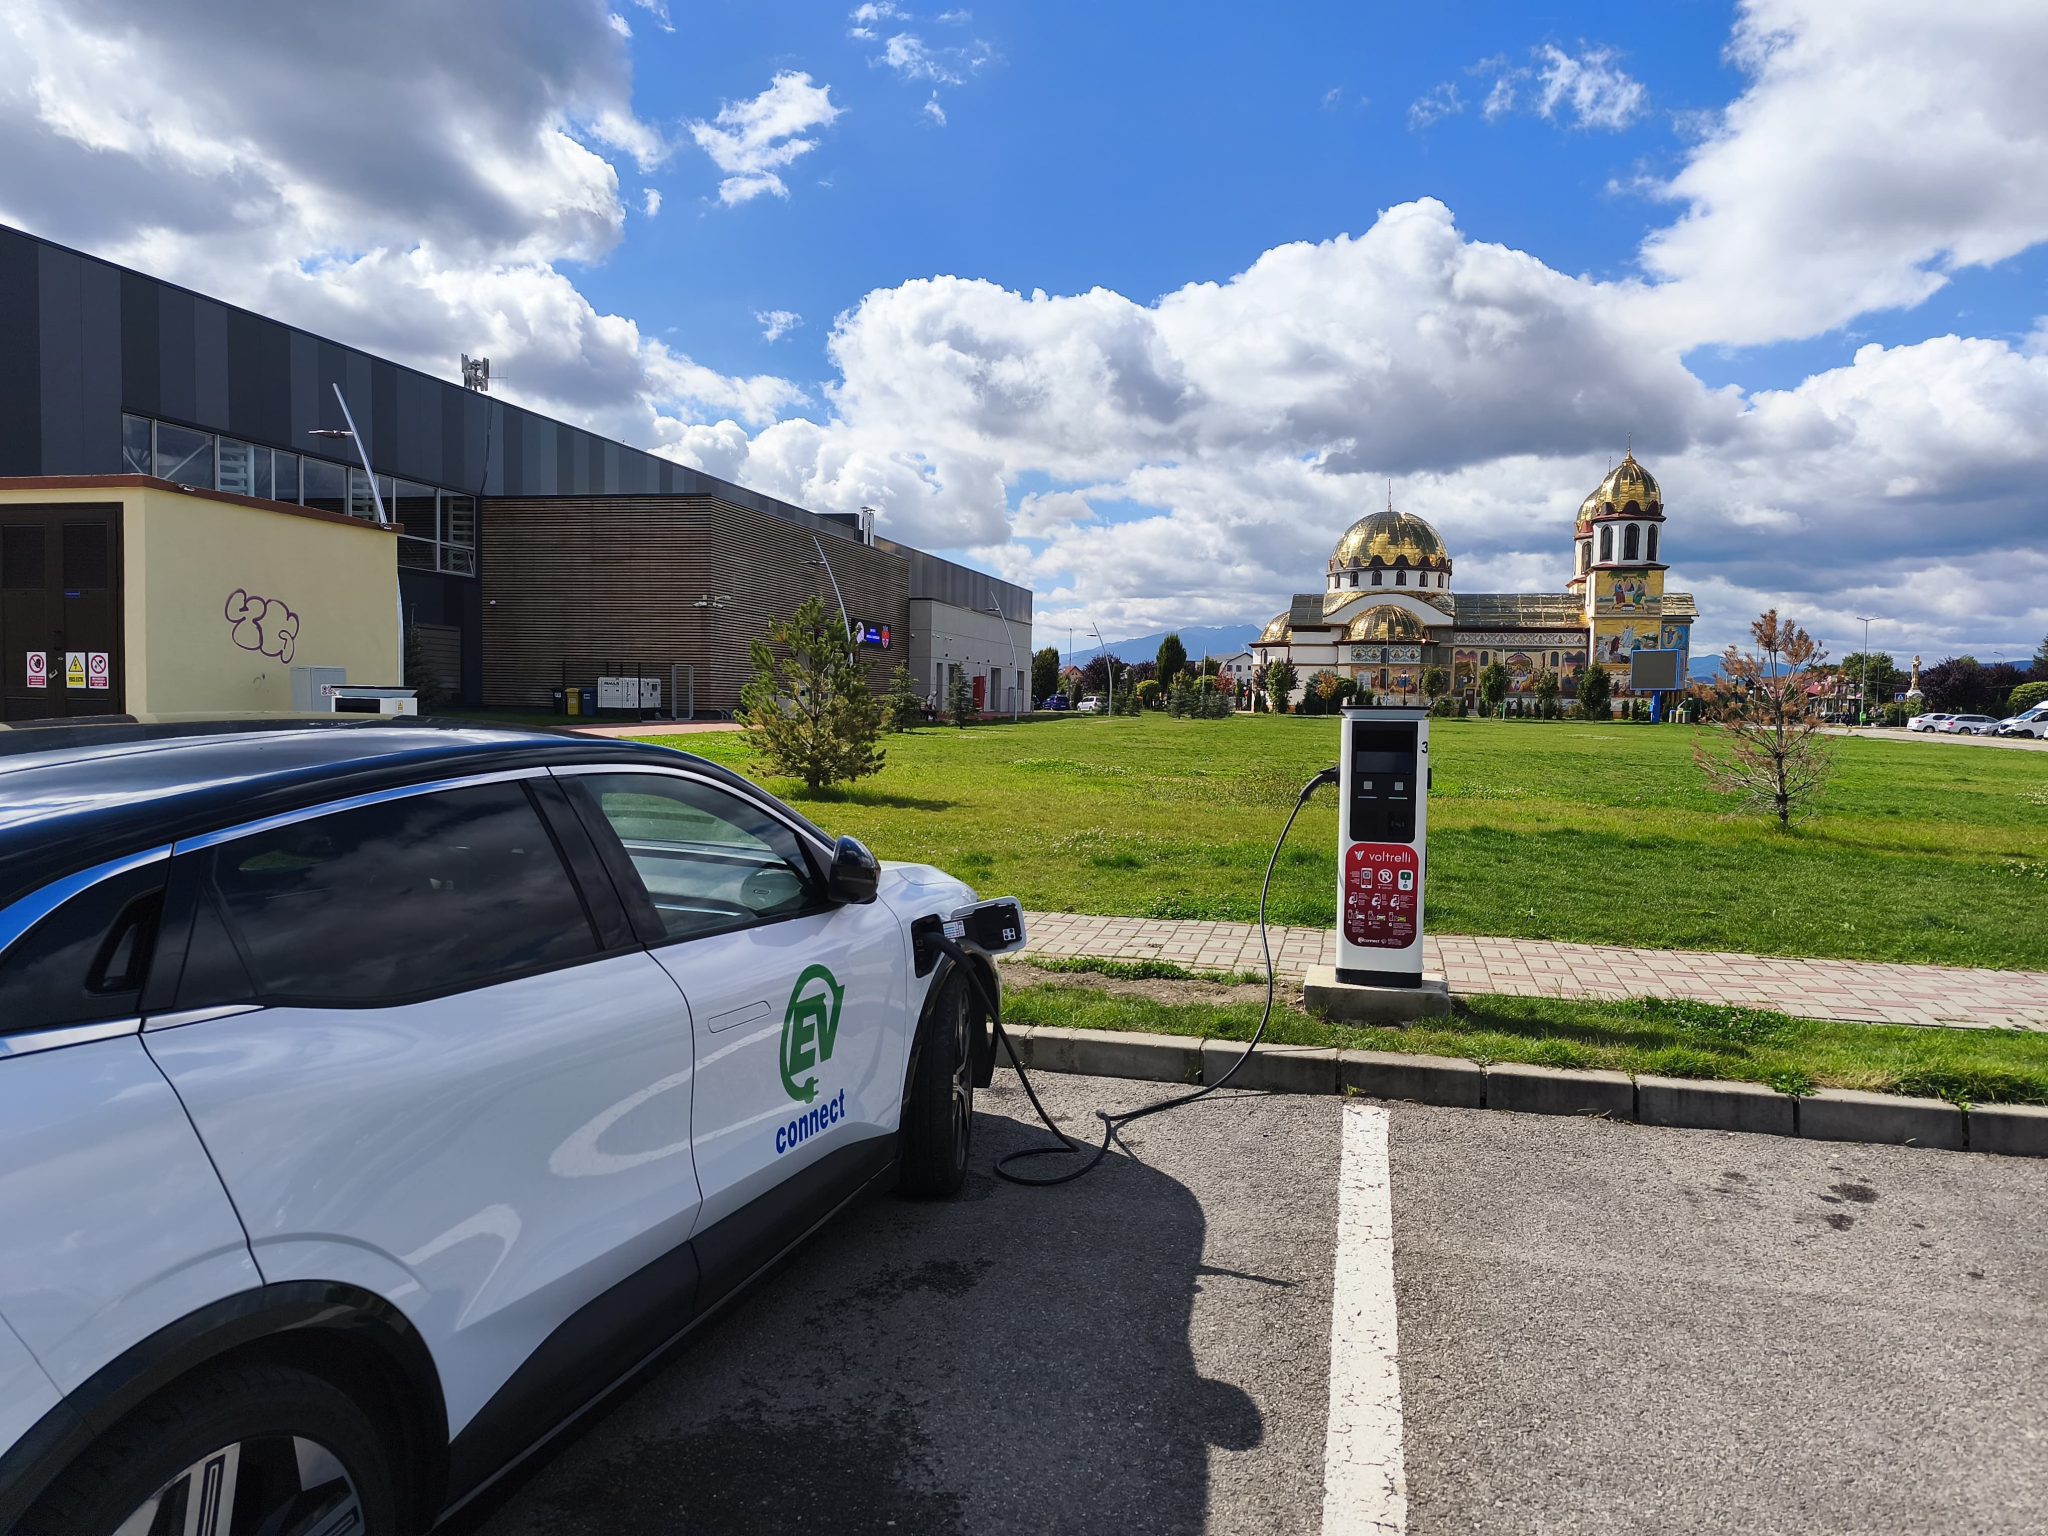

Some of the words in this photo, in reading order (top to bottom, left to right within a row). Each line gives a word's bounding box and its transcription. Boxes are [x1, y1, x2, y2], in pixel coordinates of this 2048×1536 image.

[1421, 741, 1428, 754] 3
[1369, 851, 1411, 863] voltrelli
[775, 1088, 845, 1154] connect
